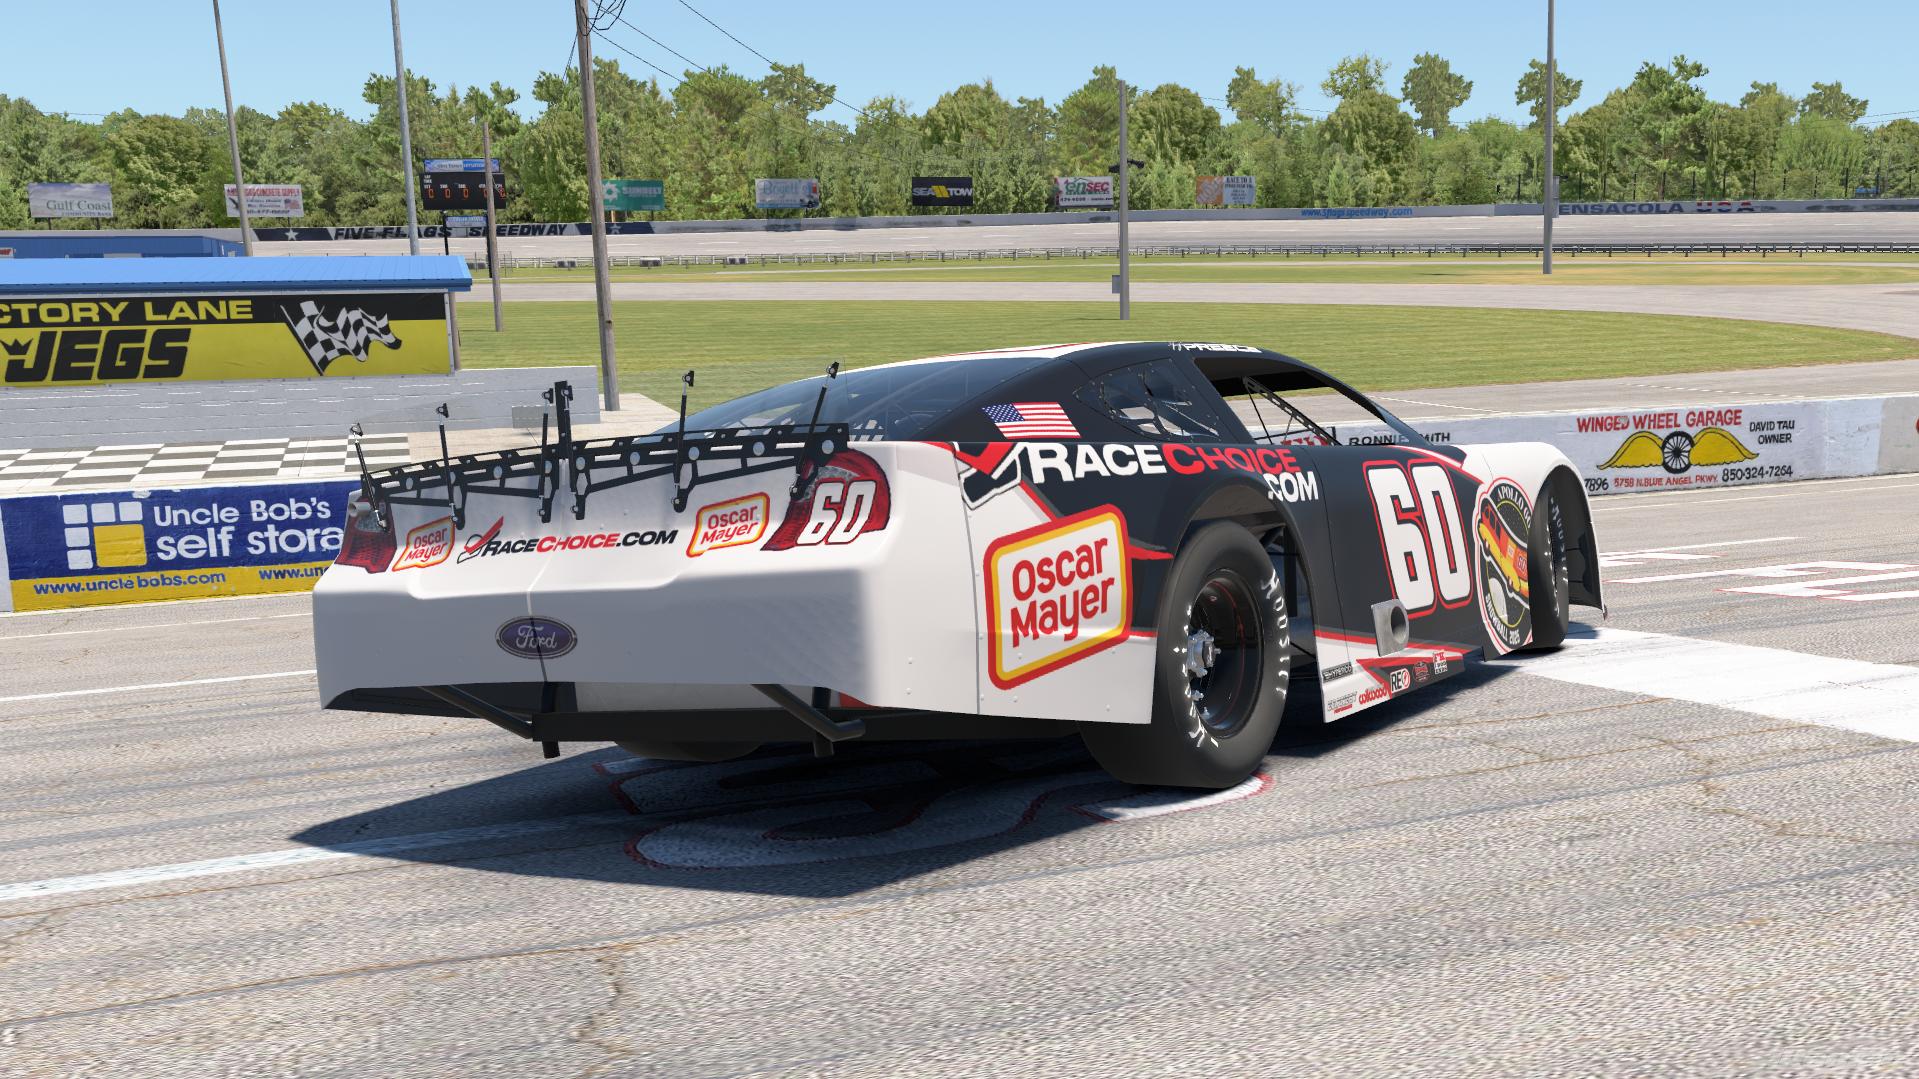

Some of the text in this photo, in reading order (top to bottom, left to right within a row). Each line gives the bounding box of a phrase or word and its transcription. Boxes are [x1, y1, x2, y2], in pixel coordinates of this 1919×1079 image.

[912, 187, 973, 197] SEA TOW
[46, 200, 111, 211] Gulf Coast
[1558, 202, 1684, 215] ENSACOLA
[334, 223, 568, 240] FIVE FLGS SEEDWAY
[144, 300, 254, 321] LANE
[5, 327, 192, 383] JEGS
[1576, 409, 1743, 433] WINGED WHEEL GARAGE
[1749, 419, 1795, 432] DAVID TAU
[1419, 432, 1451, 443] MITH
[1758, 433, 1793, 445] OWNER
[1026, 442, 1300, 485] RACECHOICE
[1664, 475, 1693, 486] ANGEL
[1497, 486, 1524, 511] APOLLO
[154, 496, 332, 527] Uncle Bob's
[707, 505, 758, 530] Oscar
[796, 479, 877, 546] 60
[157, 526, 236, 561] self
[413, 526, 448, 549] Oscar
[481, 529, 679, 556] RACECHOICE.COM
[700, 521, 759, 545] Mayer
[1366, 463, 1472, 614] 60
[405, 542, 447, 563] Mayer
[1012, 537, 1108, 602] Oscar
[33, 571, 227, 594] www.unclebobs.com
[1010, 577, 1115, 648] Mayer
[514, 623, 559, 650] Ford
